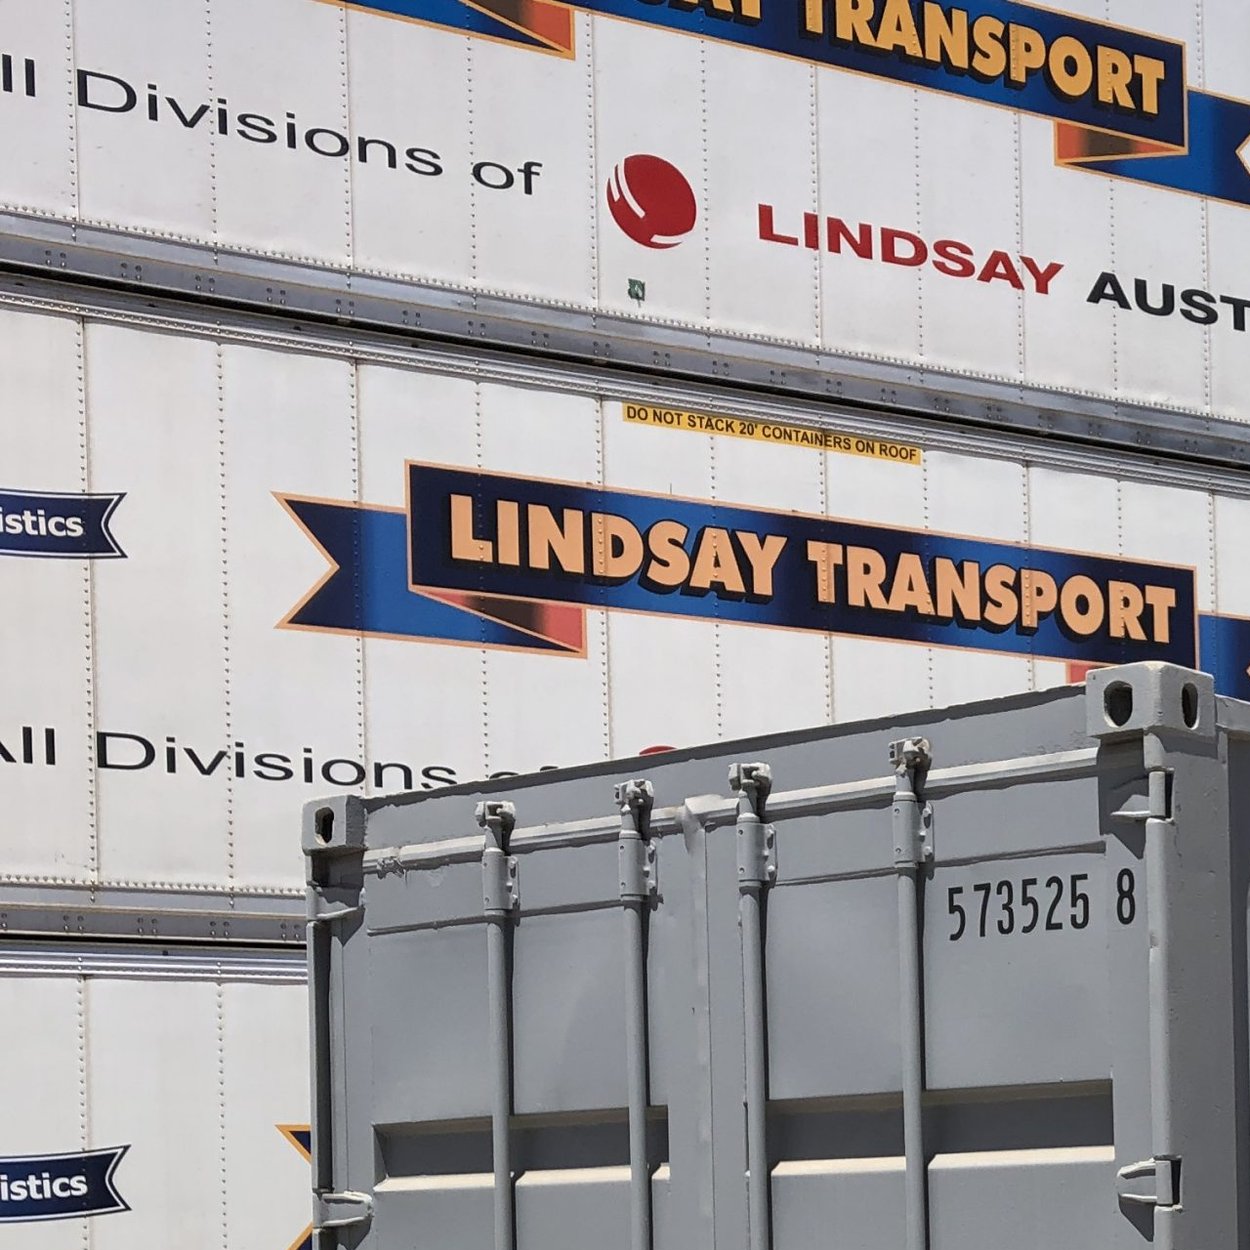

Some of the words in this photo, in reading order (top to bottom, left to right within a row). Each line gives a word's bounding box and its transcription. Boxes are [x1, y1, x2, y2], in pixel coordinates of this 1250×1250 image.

[77, 69, 443, 176] Divisions
[472, 161, 543, 196] of
[757, 204, 1064, 295] LINDSAY
[626, 405, 649, 421] DO
[652, 408, 683, 426] NOT
[687, 414, 735, 434] STACK
[739, 421, 758, 436] 20'
[762, 425, 851, 450] CONTAINERS
[855, 439, 875, 454] ON
[879, 443, 917, 461] ROOF
[451, 494, 787, 596] LINDSAY
[807, 540, 1176, 643] TRANSPORT
[0, 727, 56, 765] ll
[96, 731, 457, 789] Divisions
[948, 872, 1090, 940] 573525
[1116, 868, 1136, 925] 8
[0, 1172, 88, 1201] istics
